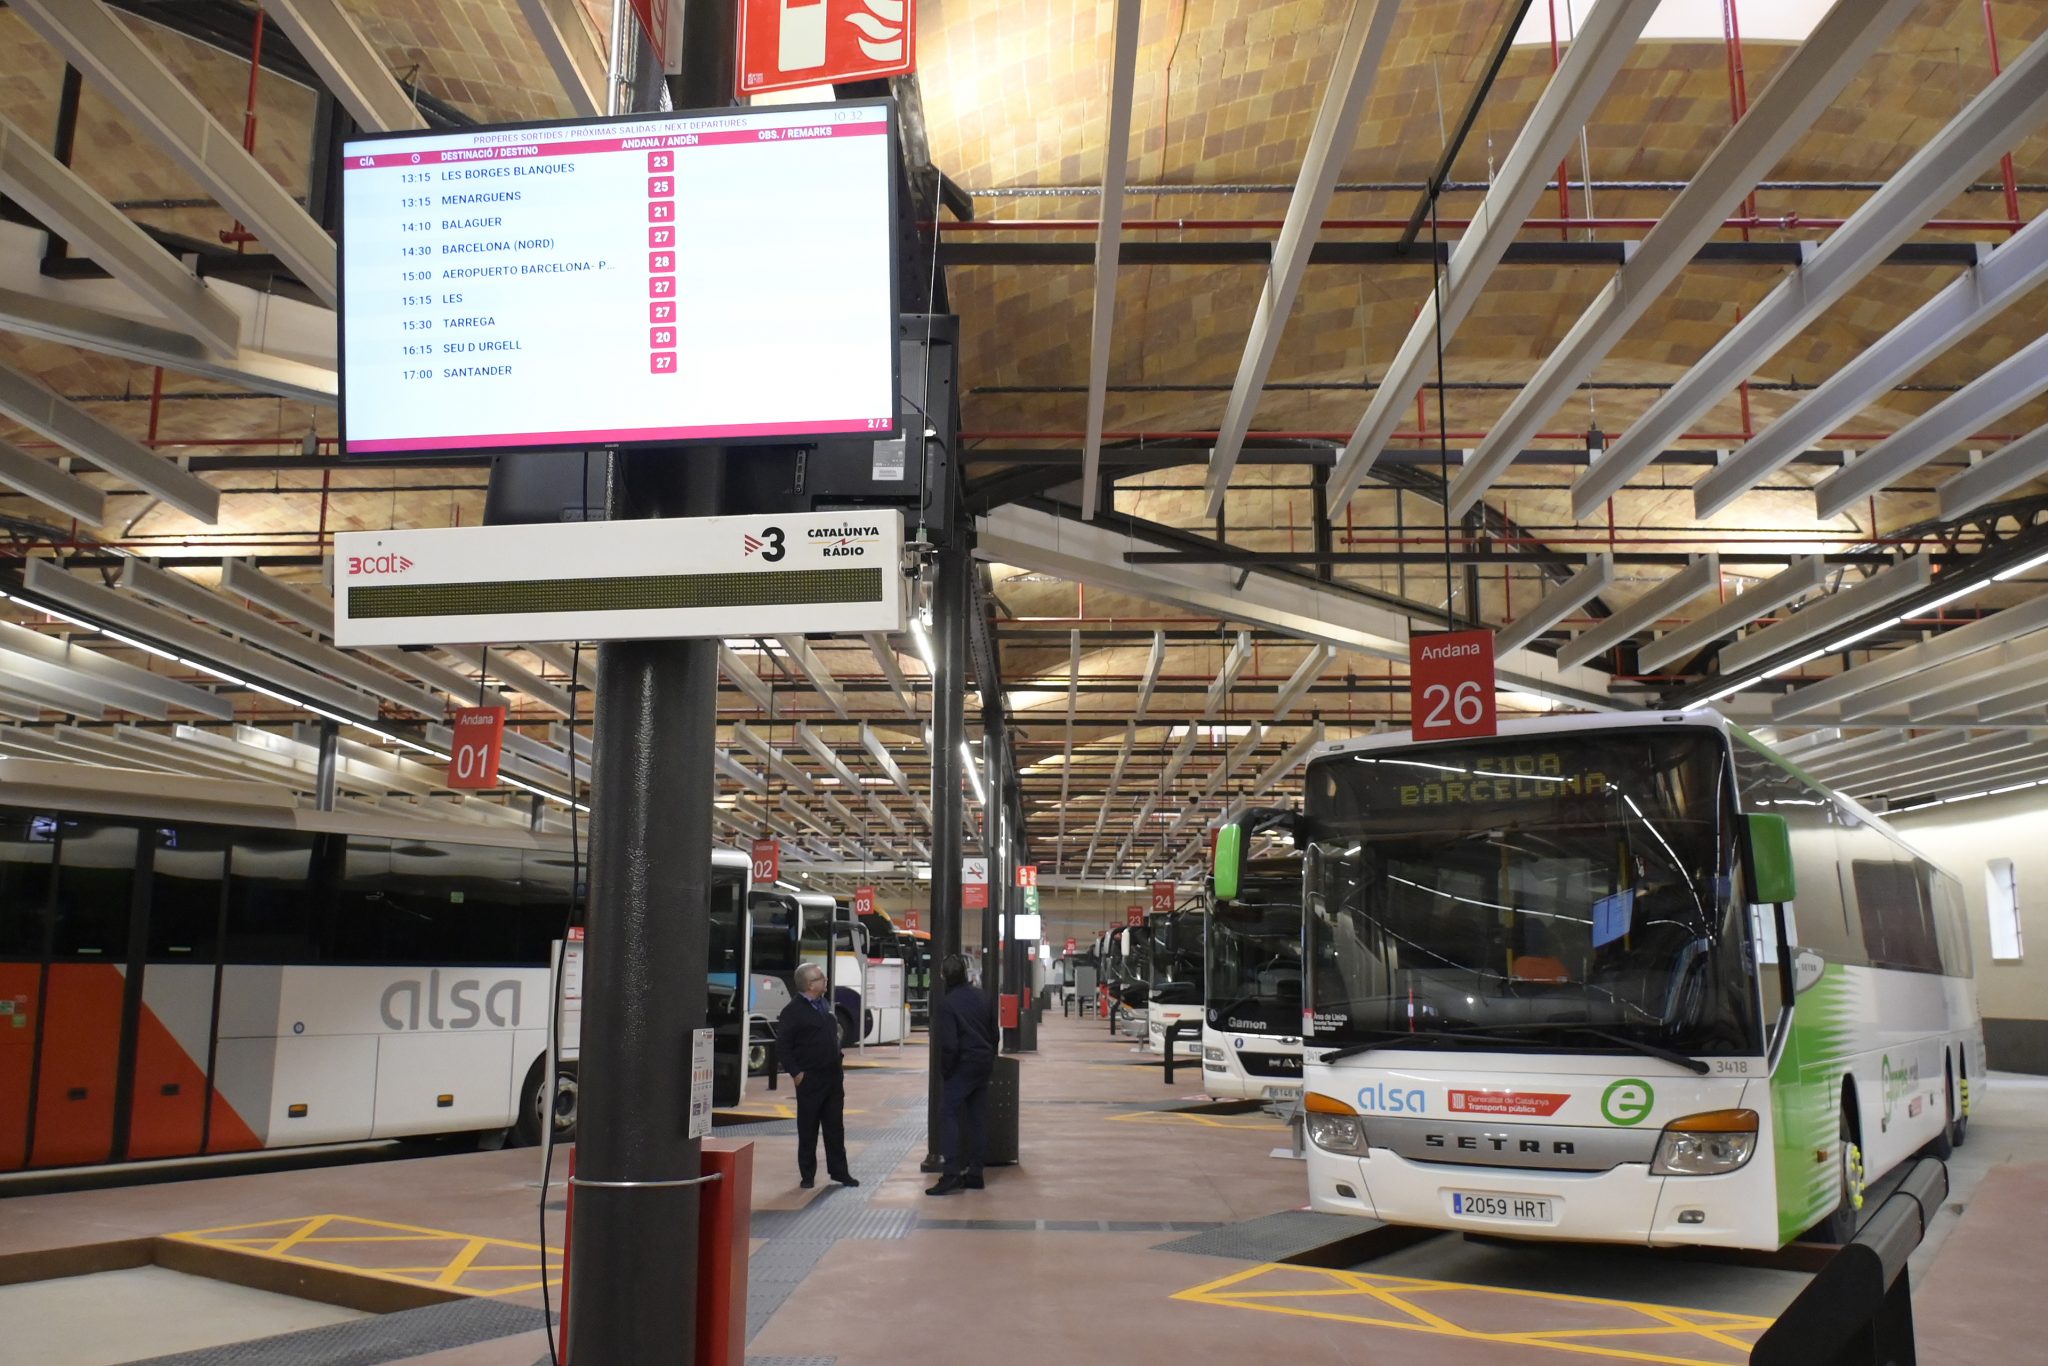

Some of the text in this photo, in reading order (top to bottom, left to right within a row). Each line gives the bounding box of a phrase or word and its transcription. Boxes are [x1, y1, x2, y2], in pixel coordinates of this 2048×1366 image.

[473, 133, 519, 145] PROPERES
[520, 130, 563, 142] SORTIDES
[570, 126, 617, 139] PRÓXIMAS
[619, 123, 658, 135] SALIDAS
[664, 121, 688, 132] NEXT
[690, 118, 748, 130] DEPARTURES
[758, 129, 780, 140] OBS.
[787, 126, 832, 138] REMARKS
[622, 136, 660, 149] ANDANA
[666, 133, 698, 146] ANDÉN
[441, 147, 494, 162] DESTINACIÓ
[500, 146, 538, 157] DESTINO
[360, 155, 375, 167] CÍA
[654, 156, 669, 168] 23
[401, 173, 431, 184] 13:15
[441, 163, 575, 182] LES BORGES BLANQUES
[654, 181, 669, 192] 25
[401, 197, 431, 208] 13:15
[442, 191, 522, 206] MENARGUENS
[654, 206, 669, 218] 21
[402, 222, 432, 232] 14:10
[442, 217, 502, 230] BALAGUER
[654, 232, 670, 243] 27
[402, 246, 432, 257] 14:30
[442, 238, 555, 254] BARCELONA (NORD)
[654, 256, 670, 268] 28
[402, 271, 432, 282] 15:00
[442, 266, 518, 280] AEROPUERTO
[655, 282, 670, 293] 27
[402, 296, 432, 306] 15:15
[442, 294, 464, 304] LES
[656, 306, 670, 318] 27
[402, 320, 432, 331] 15:30
[443, 316, 496, 328] TARREGA
[656, 332, 671, 343] 20
[403, 344, 433, 356] 16:15
[443, 340, 522, 354] SEU D URGELL
[656, 357, 671, 368] 27
[403, 370, 433, 380] 17:00
[444, 365, 513, 378] SANTANDER
[808, 527, 880, 538] CATALUNYA
[761, 526, 786, 562] 3
[348, 554, 398, 575] 3cat
[1420, 641, 1480, 661] Andana
[1422, 681, 1484, 728] 26
[460, 713, 494, 725] Andana
[457, 744, 488, 778] 01
[754, 860, 773, 878] 02
[856, 899, 870, 912] 03
[1156, 896, 1172, 909] 24
[906, 920, 916, 928] 04
[1129, 916, 1140, 926] 23
[380, 968, 522, 1030] alsa
[1716, 1061, 1748, 1074] 3418
[1358, 1082, 1426, 1114] alsa
[1468, 1103, 1506, 1112] Transports
[1426, 1134, 1576, 1156] SETRA
[1465, 1196, 1547, 1219] 2059 HRT
